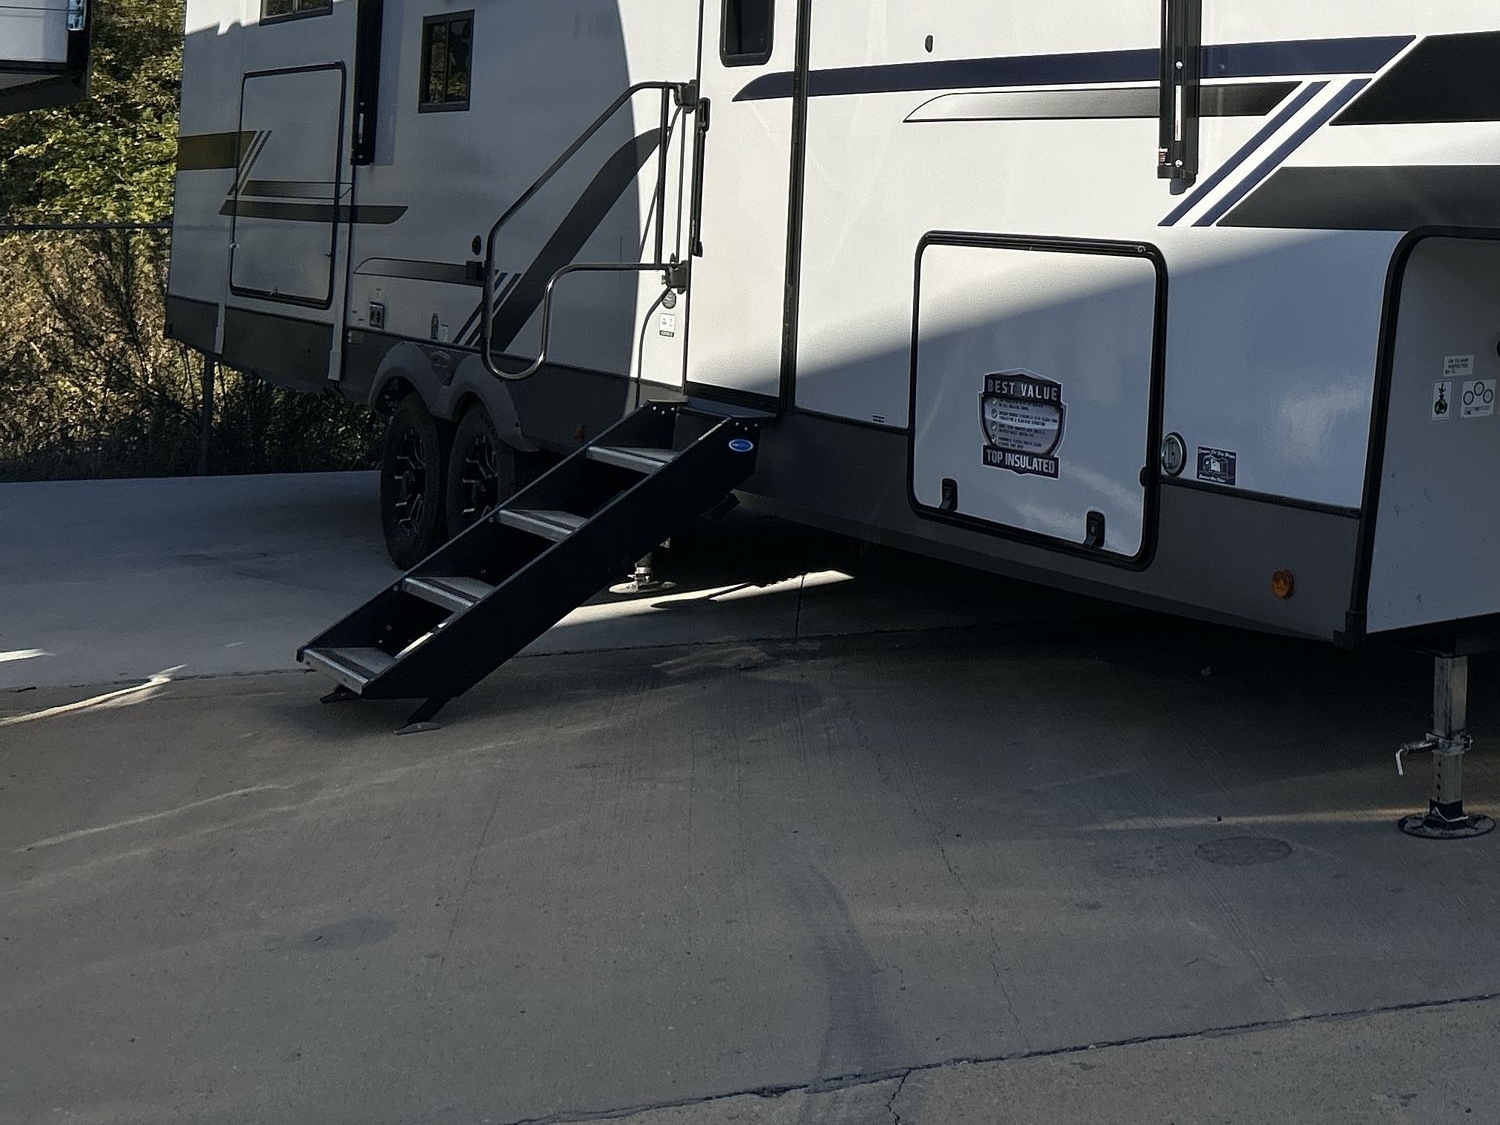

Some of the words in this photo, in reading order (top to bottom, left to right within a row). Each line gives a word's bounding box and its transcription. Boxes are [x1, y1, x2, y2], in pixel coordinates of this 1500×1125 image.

[987, 379, 1015, 395] BEST
[1020, 383, 1059, 401] VALUE
[986, 449, 1003, 464] TOP
[1005, 452, 1056, 474] INSULATED
